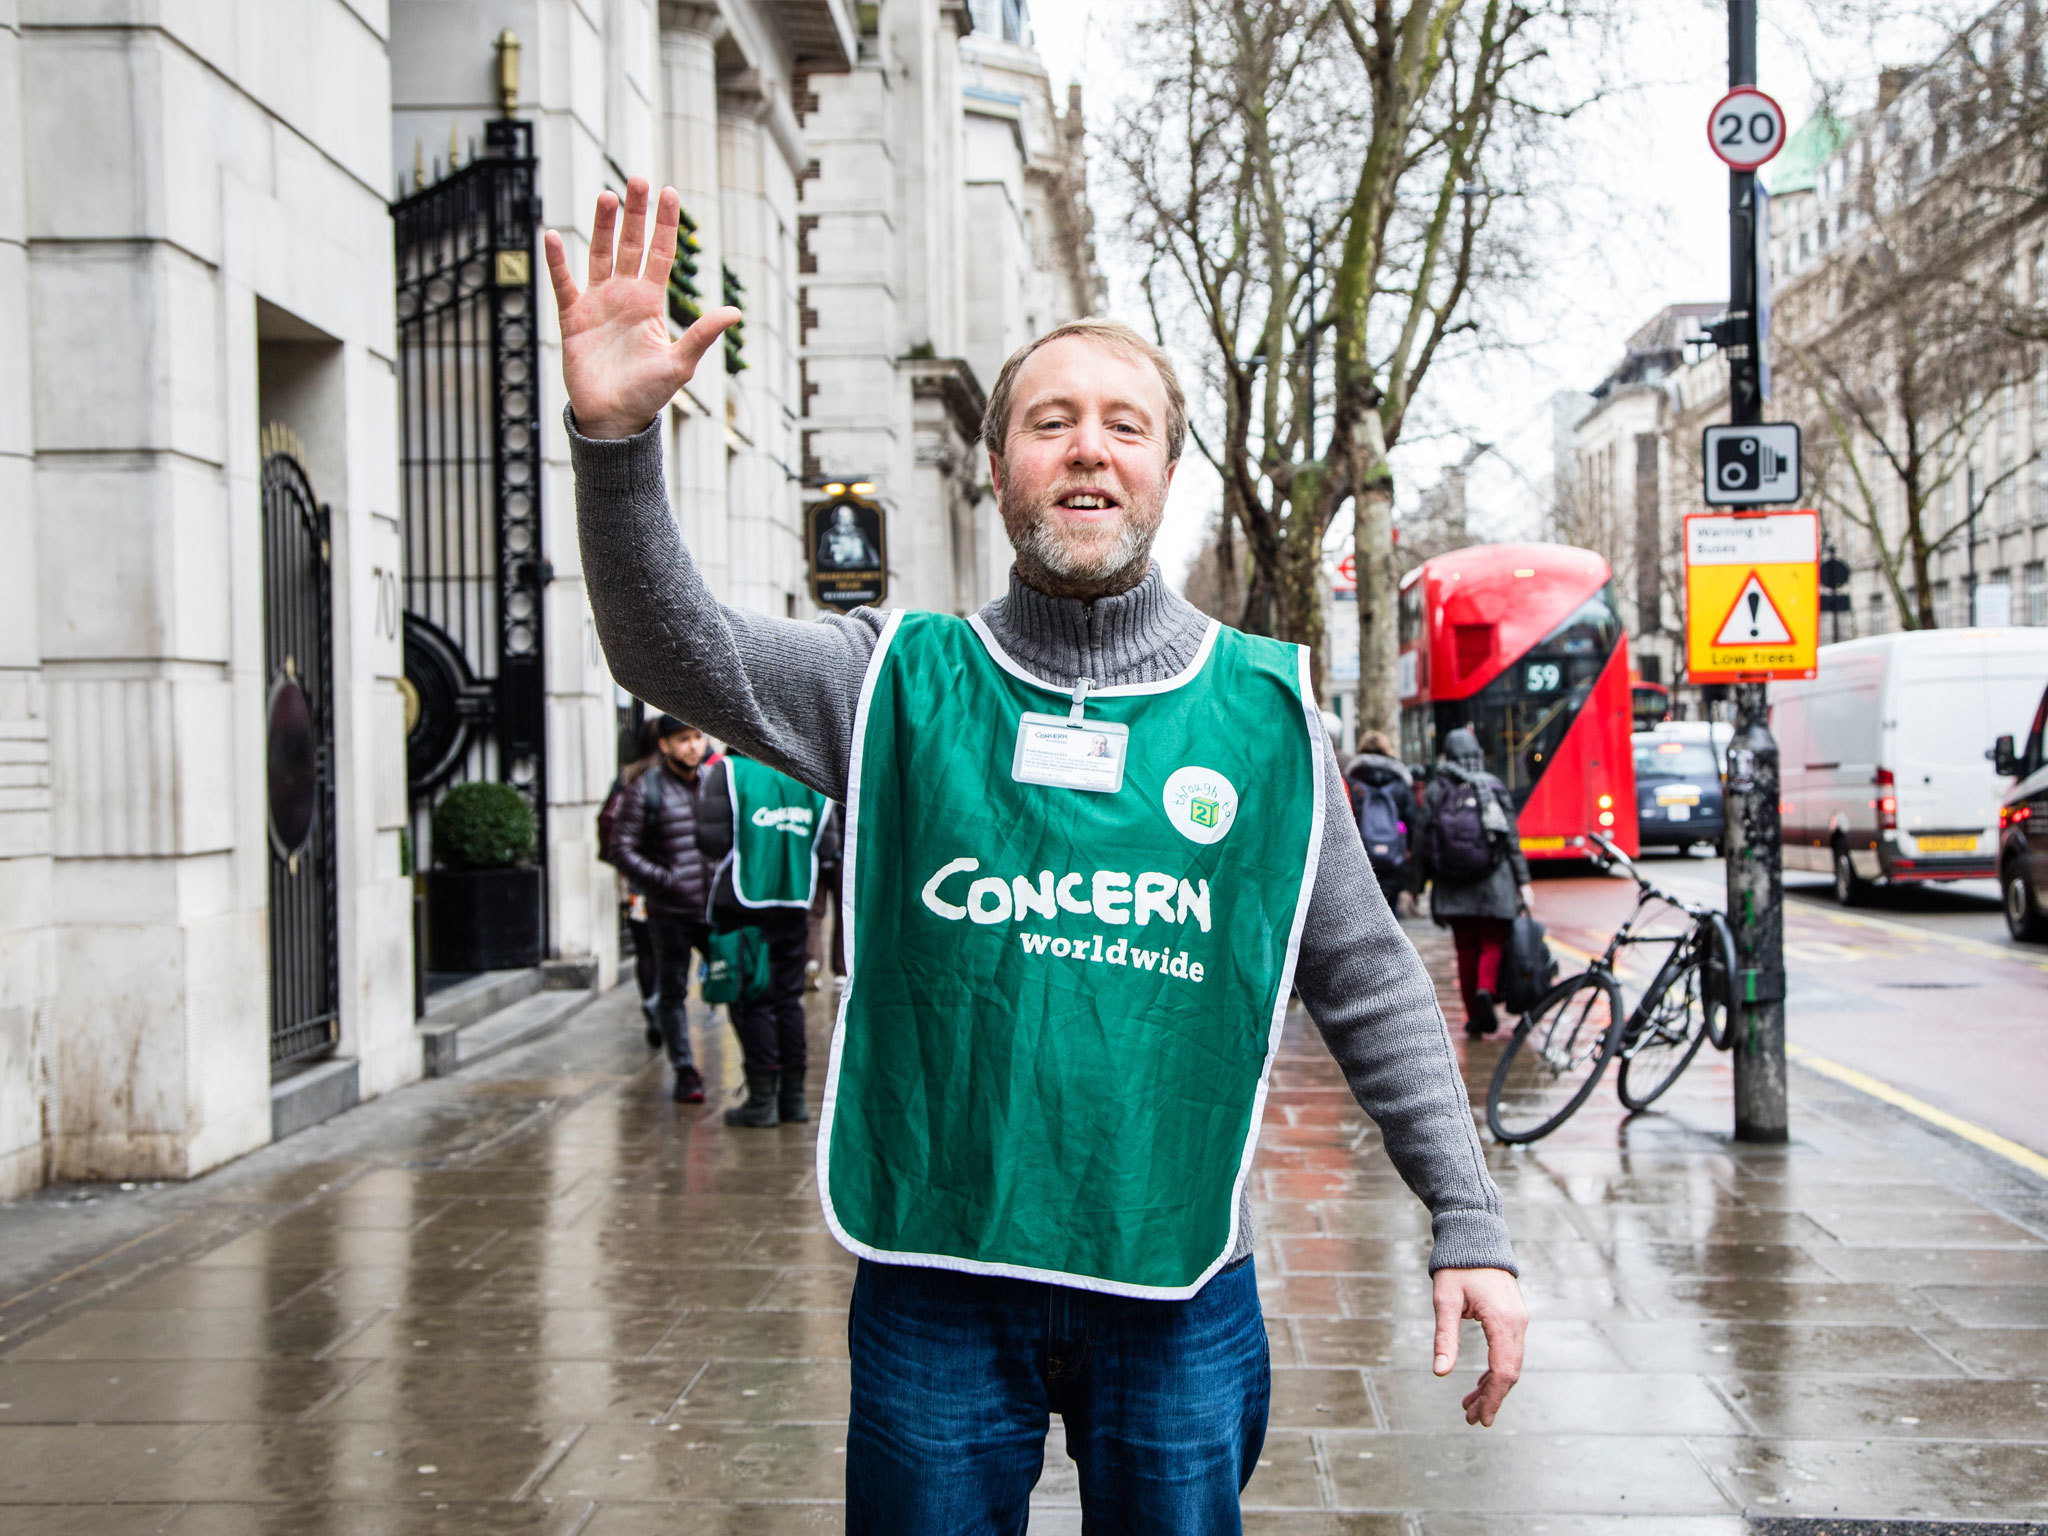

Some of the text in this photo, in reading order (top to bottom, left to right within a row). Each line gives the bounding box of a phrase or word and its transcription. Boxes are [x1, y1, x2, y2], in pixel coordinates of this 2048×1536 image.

[1719, 112, 1775, 145] 20
[1697, 526, 1754, 538] Warning
[374, 567, 398, 641] 70
[1712, 652, 1795, 665] Low trees
[1528, 664, 1560, 691] 59
[1196, 805, 1207, 822] 2
[921, 857, 1212, 933] CONCERN
[1019, 932, 1205, 983] worldwide
